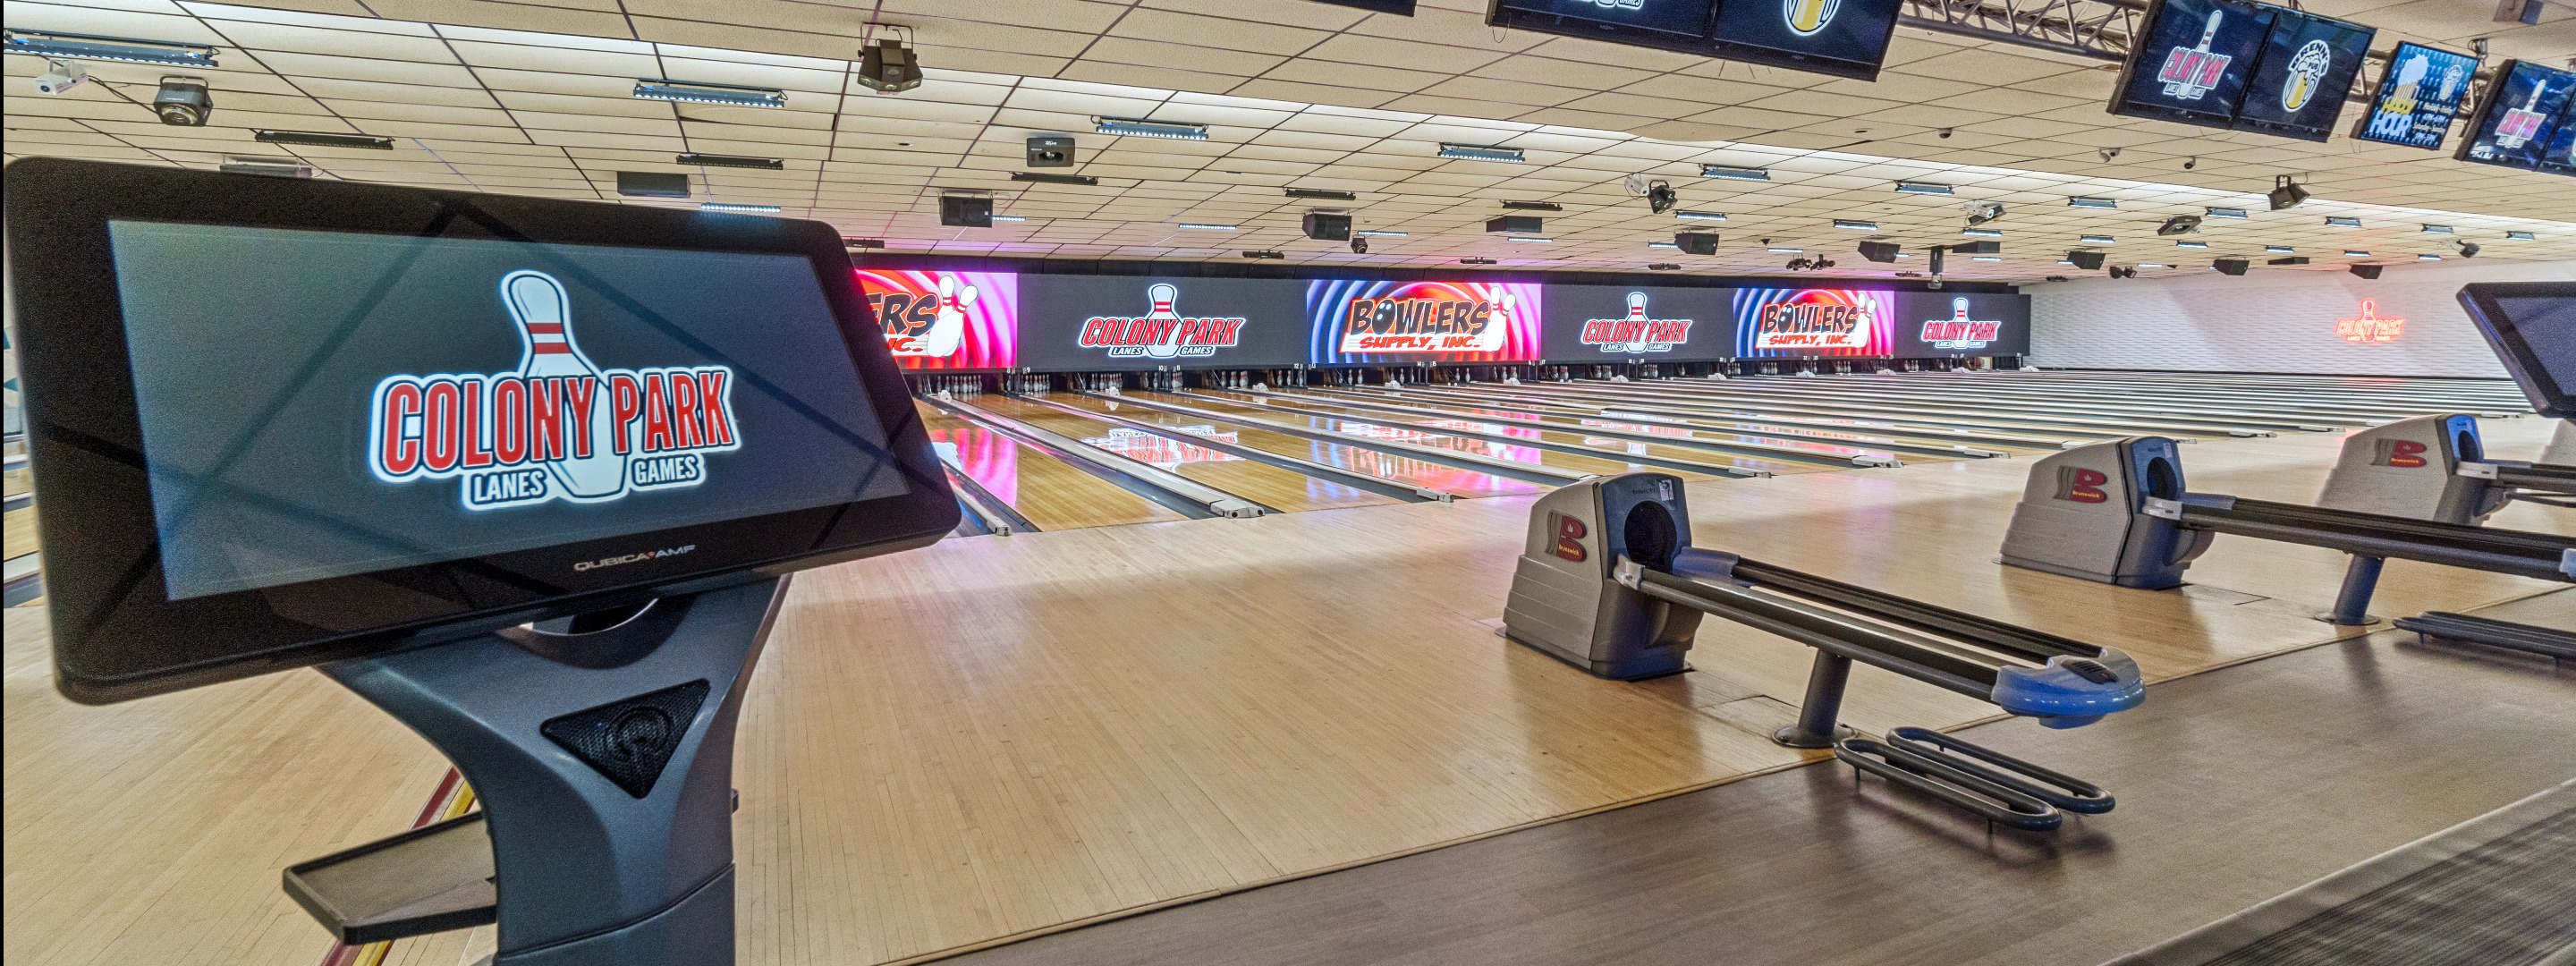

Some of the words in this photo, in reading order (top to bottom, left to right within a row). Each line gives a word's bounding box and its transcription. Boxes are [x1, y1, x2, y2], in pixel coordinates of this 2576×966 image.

[2308, 62, 2318, 70] PUB
[2368, 110, 2413, 138] HOUR
[1351, 299, 1490, 335] BOWLERS
[1762, 303, 1859, 335] BOWLERS
[2375, 319, 2404, 335] PARK
[1081, 318, 1180, 346] COLONY
[1176, 318, 1242, 346] PARK
[1583, 320, 1647, 343] COLONY
[1646, 320, 1690, 343] PARK
[1769, 335, 1821, 346] SUPPLY,
[1826, 335, 1852, 344] INC.
[1923, 321, 1968, 341] COLONY
[1968, 321, 1999, 341] PARK
[1113, 346, 1144, 355] LANES
[1181, 346, 1213, 355] GAMES
[1360, 336, 1436, 350] SUPPLY,
[1442, 336, 1481, 349] INC.
[383, 376, 597, 475] COLONY
[611, 371, 733, 454] PARK
[474, 471, 545, 503] LANES
[633, 456, 699, 486] GAMES
[1559, 544, 1580, 556] Brunswick
